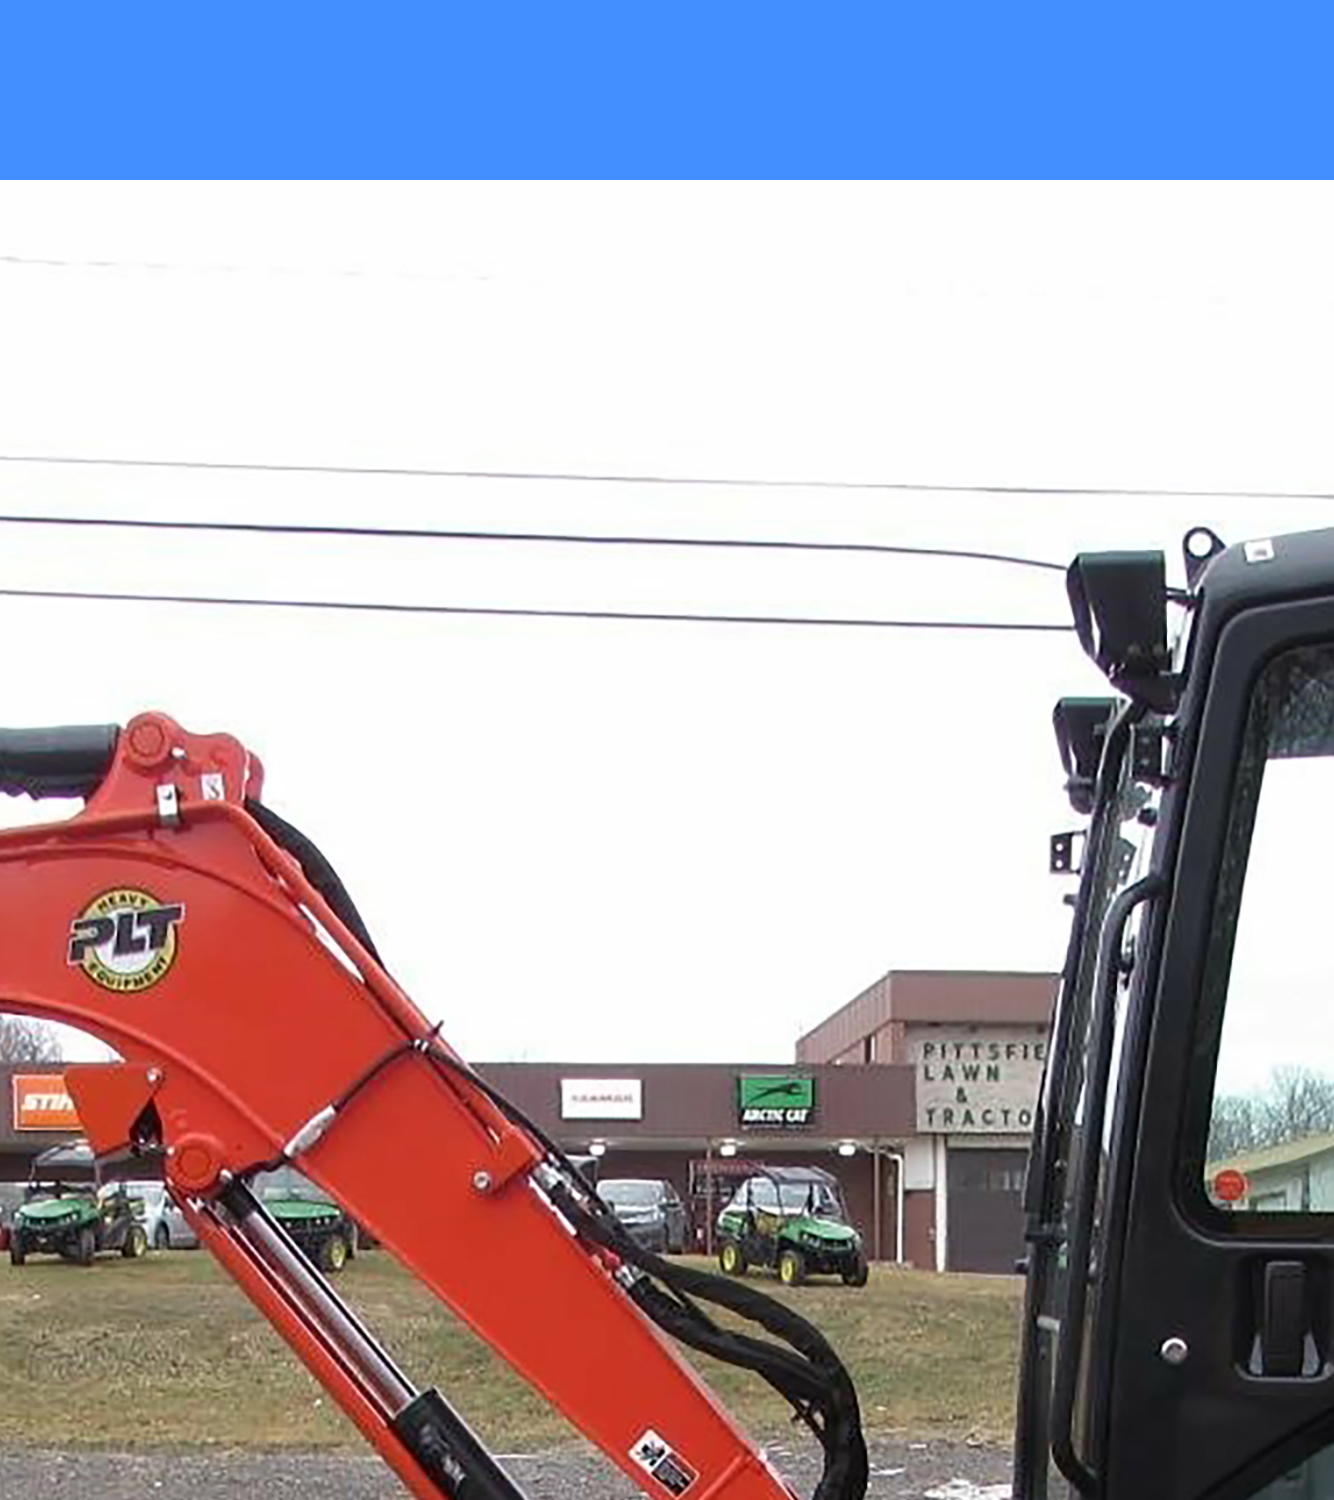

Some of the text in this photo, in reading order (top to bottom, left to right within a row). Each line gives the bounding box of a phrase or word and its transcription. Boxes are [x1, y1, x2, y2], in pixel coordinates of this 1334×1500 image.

[97, 893, 148, 912] HEAVY
[68, 904, 185, 963] PLT
[88, 956, 167, 988] EQUIPMENT
[923, 1042, 1045, 1061] PITTSFIE
[923, 1064, 999, 1082] LAWN
[20, 1093, 76, 1111] STIH
[955, 1086, 968, 1104] &
[742, 1109, 810, 1123] ARCTIC CAT
[925, 1107, 1032, 1127] TRACTO
